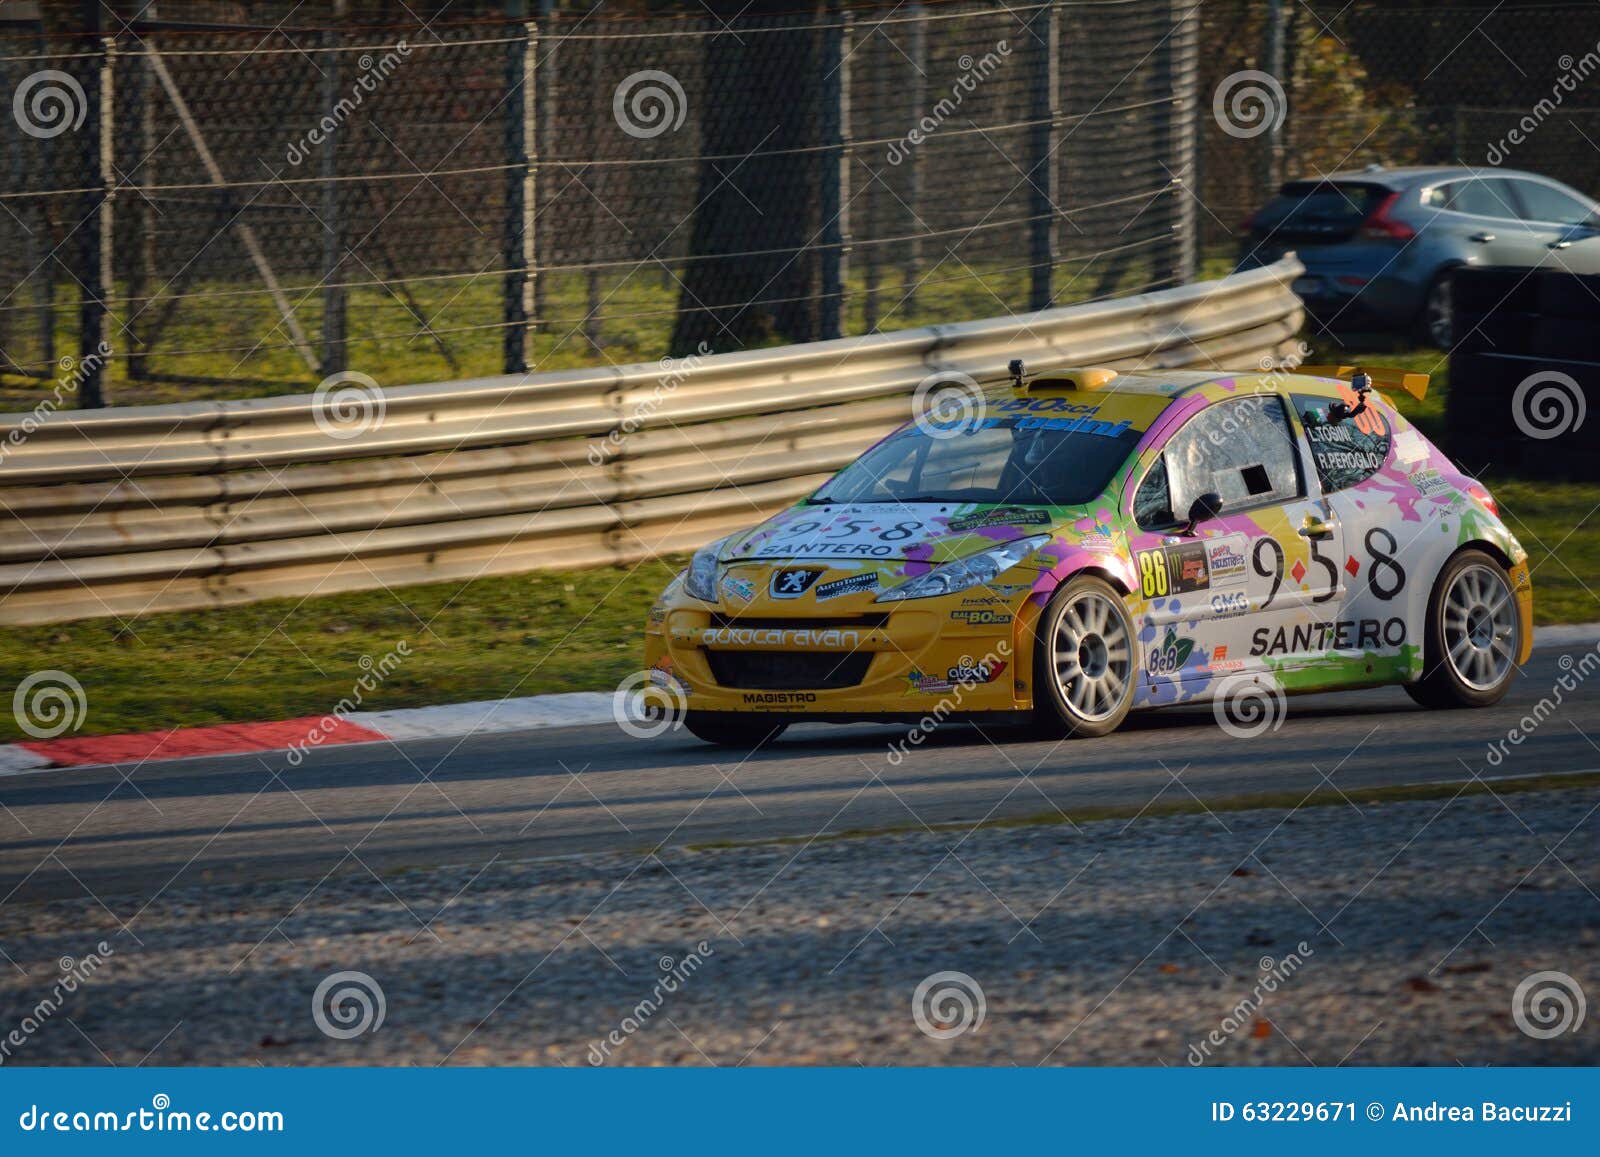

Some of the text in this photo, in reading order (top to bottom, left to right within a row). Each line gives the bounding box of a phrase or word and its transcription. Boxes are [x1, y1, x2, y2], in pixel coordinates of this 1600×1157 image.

[757, 543, 893, 556] SANTERO
[1140, 550, 1168, 597] 86
[702, 627, 858, 647] autocaravan
[1250, 616, 1407, 656] SANTERO
[743, 693, 817, 704] MAGISTRO
